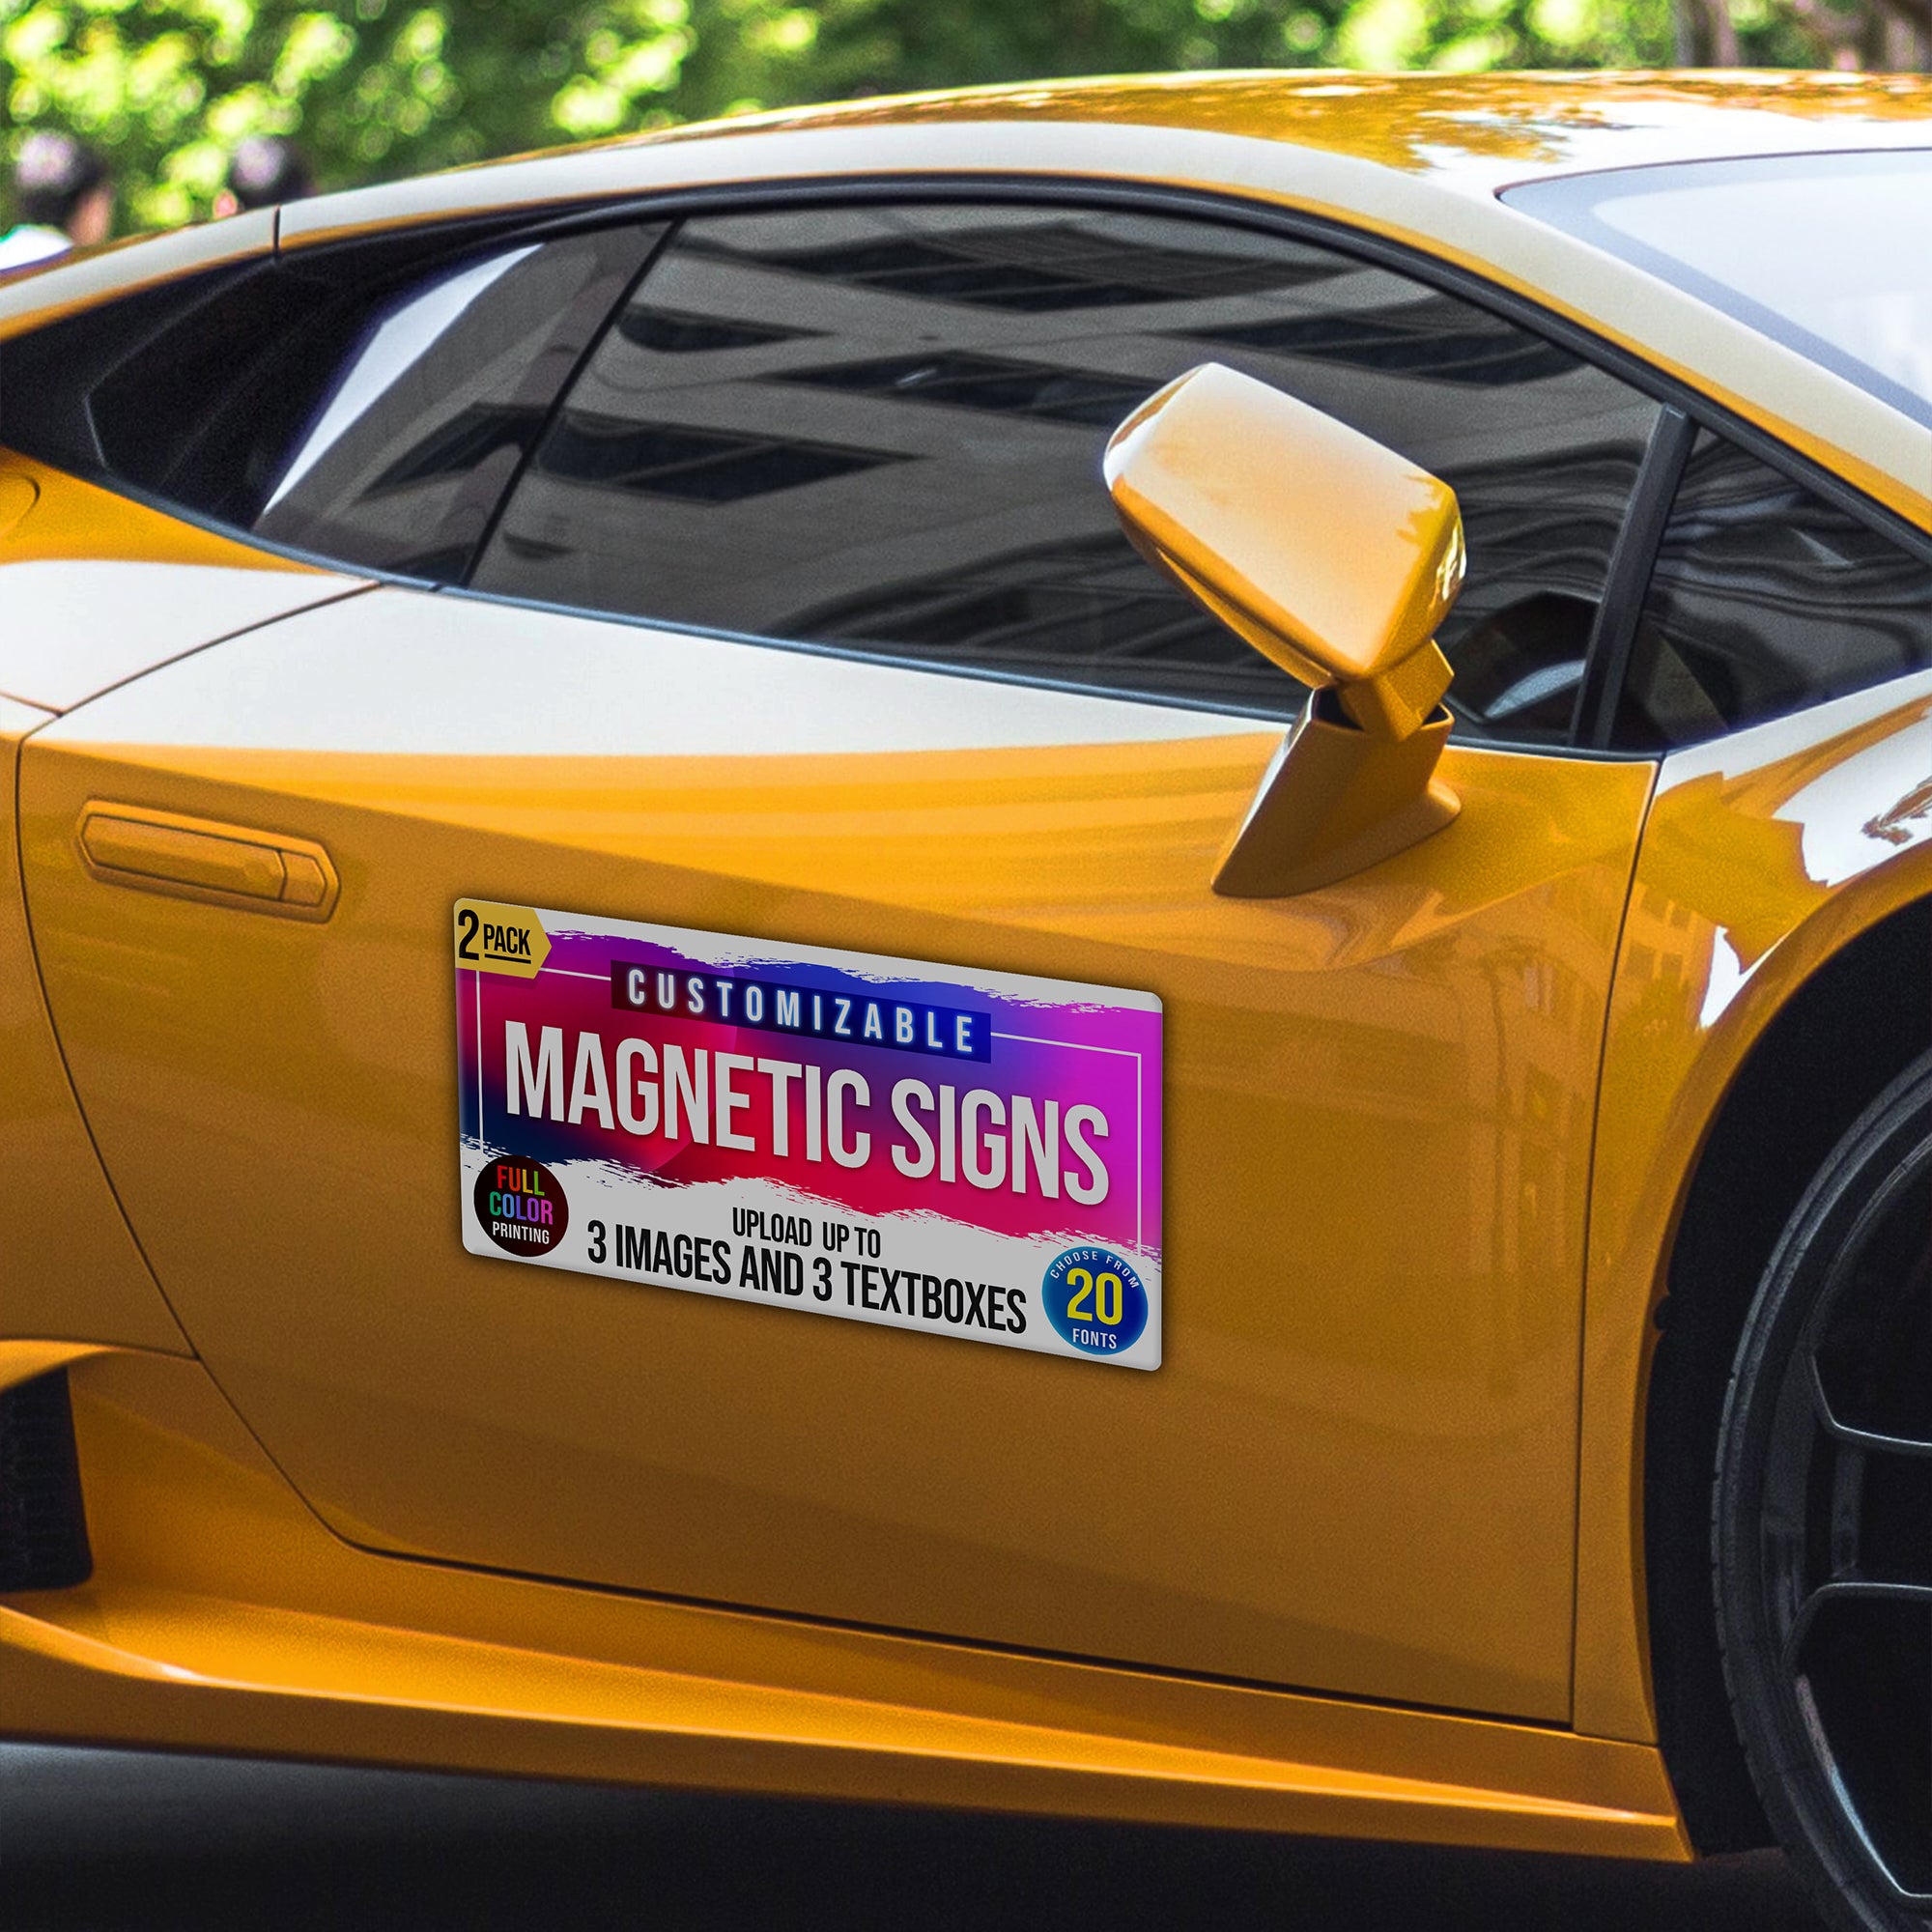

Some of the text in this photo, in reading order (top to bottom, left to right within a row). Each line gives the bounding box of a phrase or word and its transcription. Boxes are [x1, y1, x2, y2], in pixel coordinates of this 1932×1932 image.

[458, 909, 531, 960] 2 PACK
[628, 969, 973, 1053] CUSTOMIZABLE
[505, 1020, 1109, 1205] MAGNETIC SIGNS
[497, 1165, 545, 1196] FULL
[490, 1191, 554, 1225] COLOR
[493, 1221, 550, 1244] PRINTING
[732, 1208, 881, 1258] UPLOAD UP TO
[587, 1220, 1027, 1334] 3 IMAGES AND 3 TEXTBOXES
[1050, 1250, 1140, 1288] CHOOSE FROM
[1066, 1267, 1122, 1325] 20
[1072, 1327, 1118, 1350] FONTS
